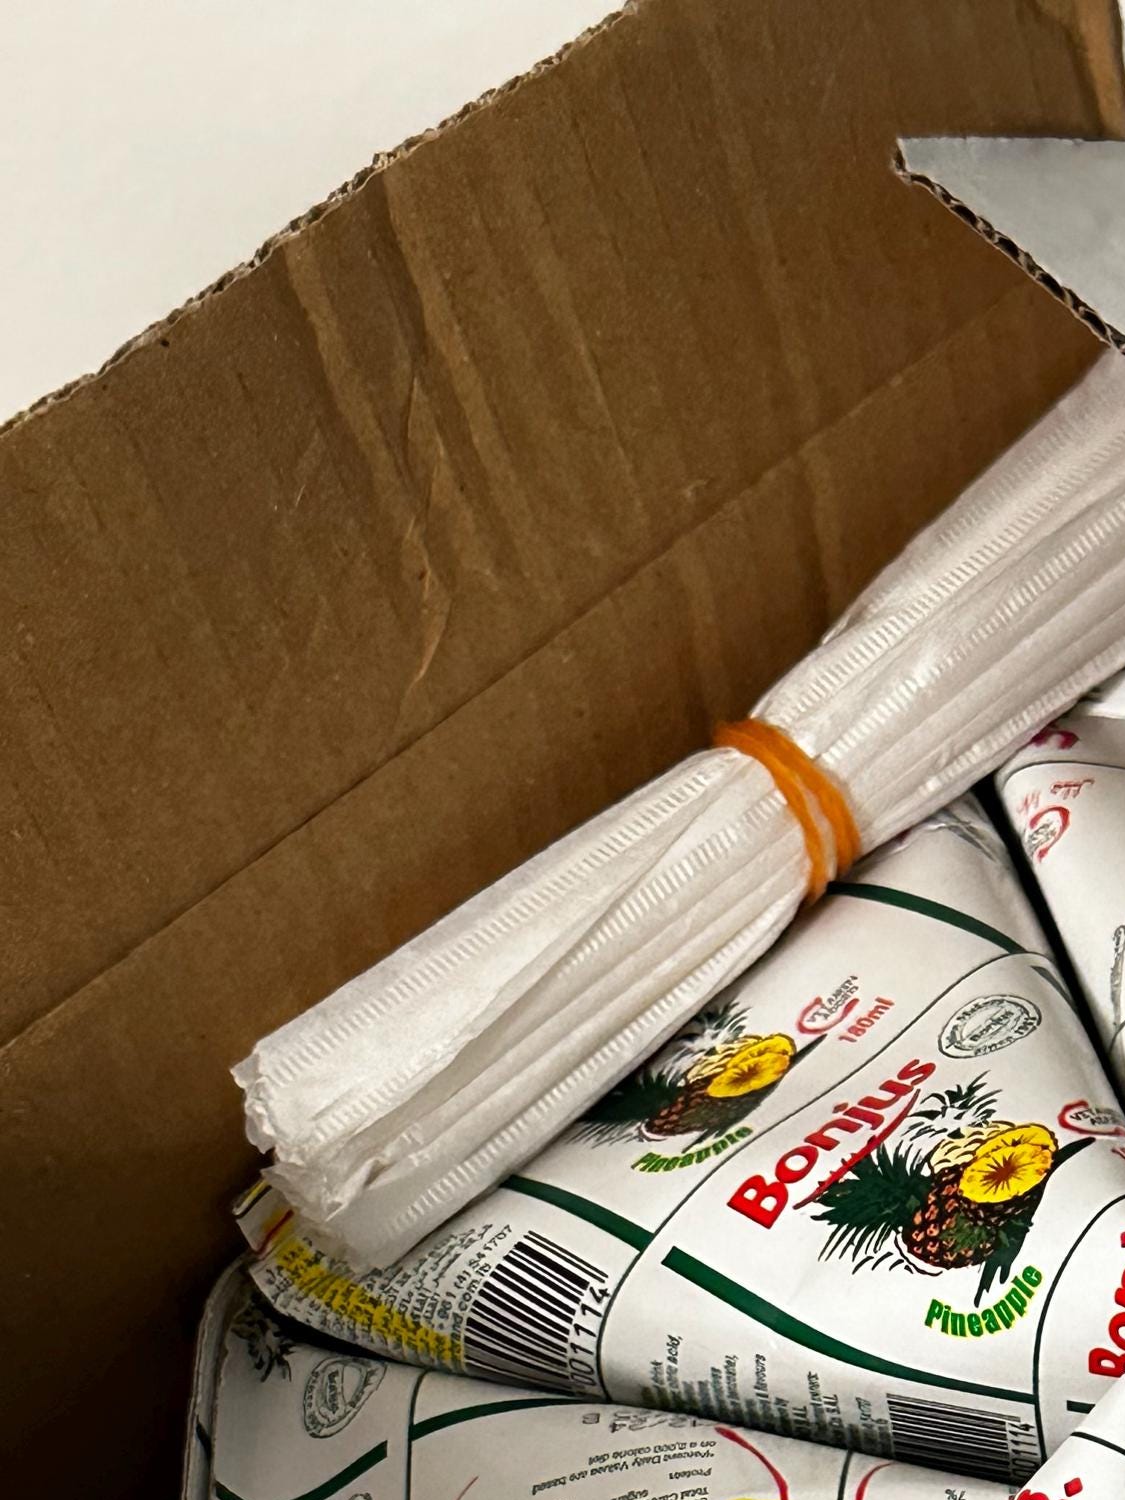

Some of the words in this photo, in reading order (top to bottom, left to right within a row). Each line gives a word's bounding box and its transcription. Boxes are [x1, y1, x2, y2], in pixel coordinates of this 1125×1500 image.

[839, 997, 894, 1042] 180ml
[727, 1059, 936, 1229] Bonjus
[925, 1266, 1042, 1337] Pineapple
